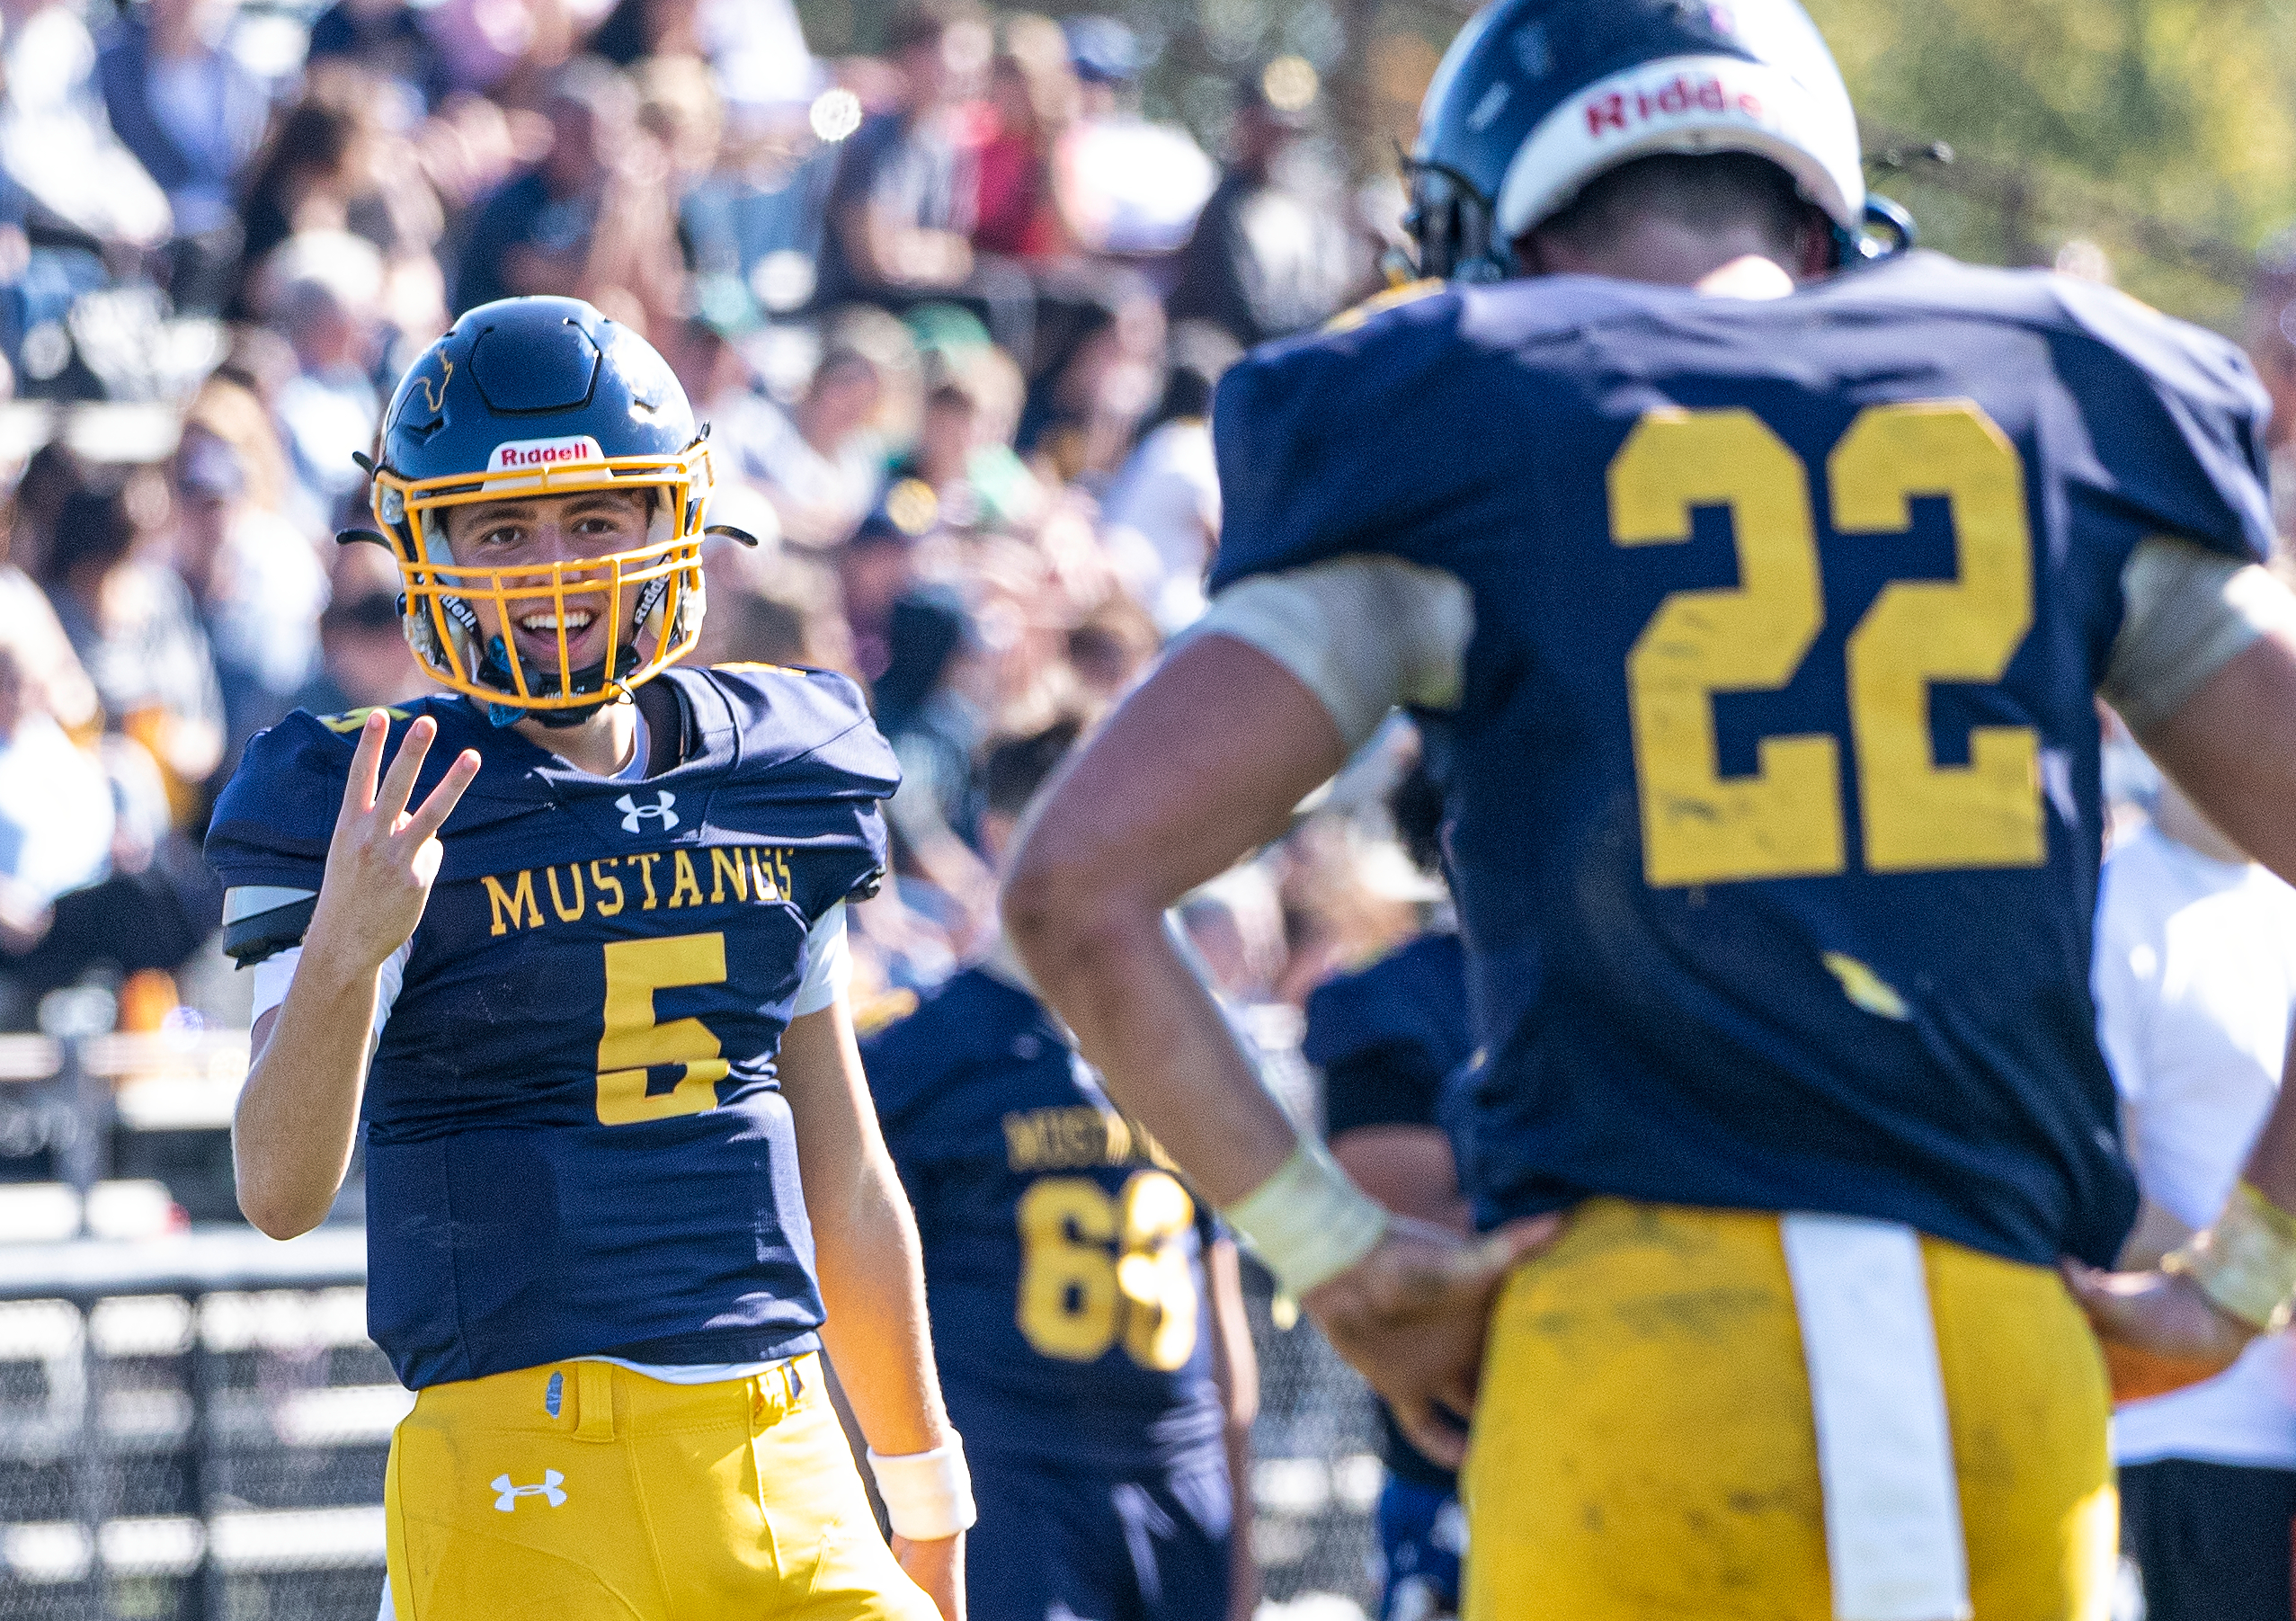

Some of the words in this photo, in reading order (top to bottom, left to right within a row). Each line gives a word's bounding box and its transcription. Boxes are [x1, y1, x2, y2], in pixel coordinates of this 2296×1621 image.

[1584, 74, 1764, 137] Ridde
[501, 441, 588, 467] Riddell
[439, 594, 477, 628] dell
[634, 574, 671, 625] Ridd
[1606, 397, 2048, 888] 22
[481, 847, 794, 937] MUSTANGS
[596, 931, 730, 1127] 5
